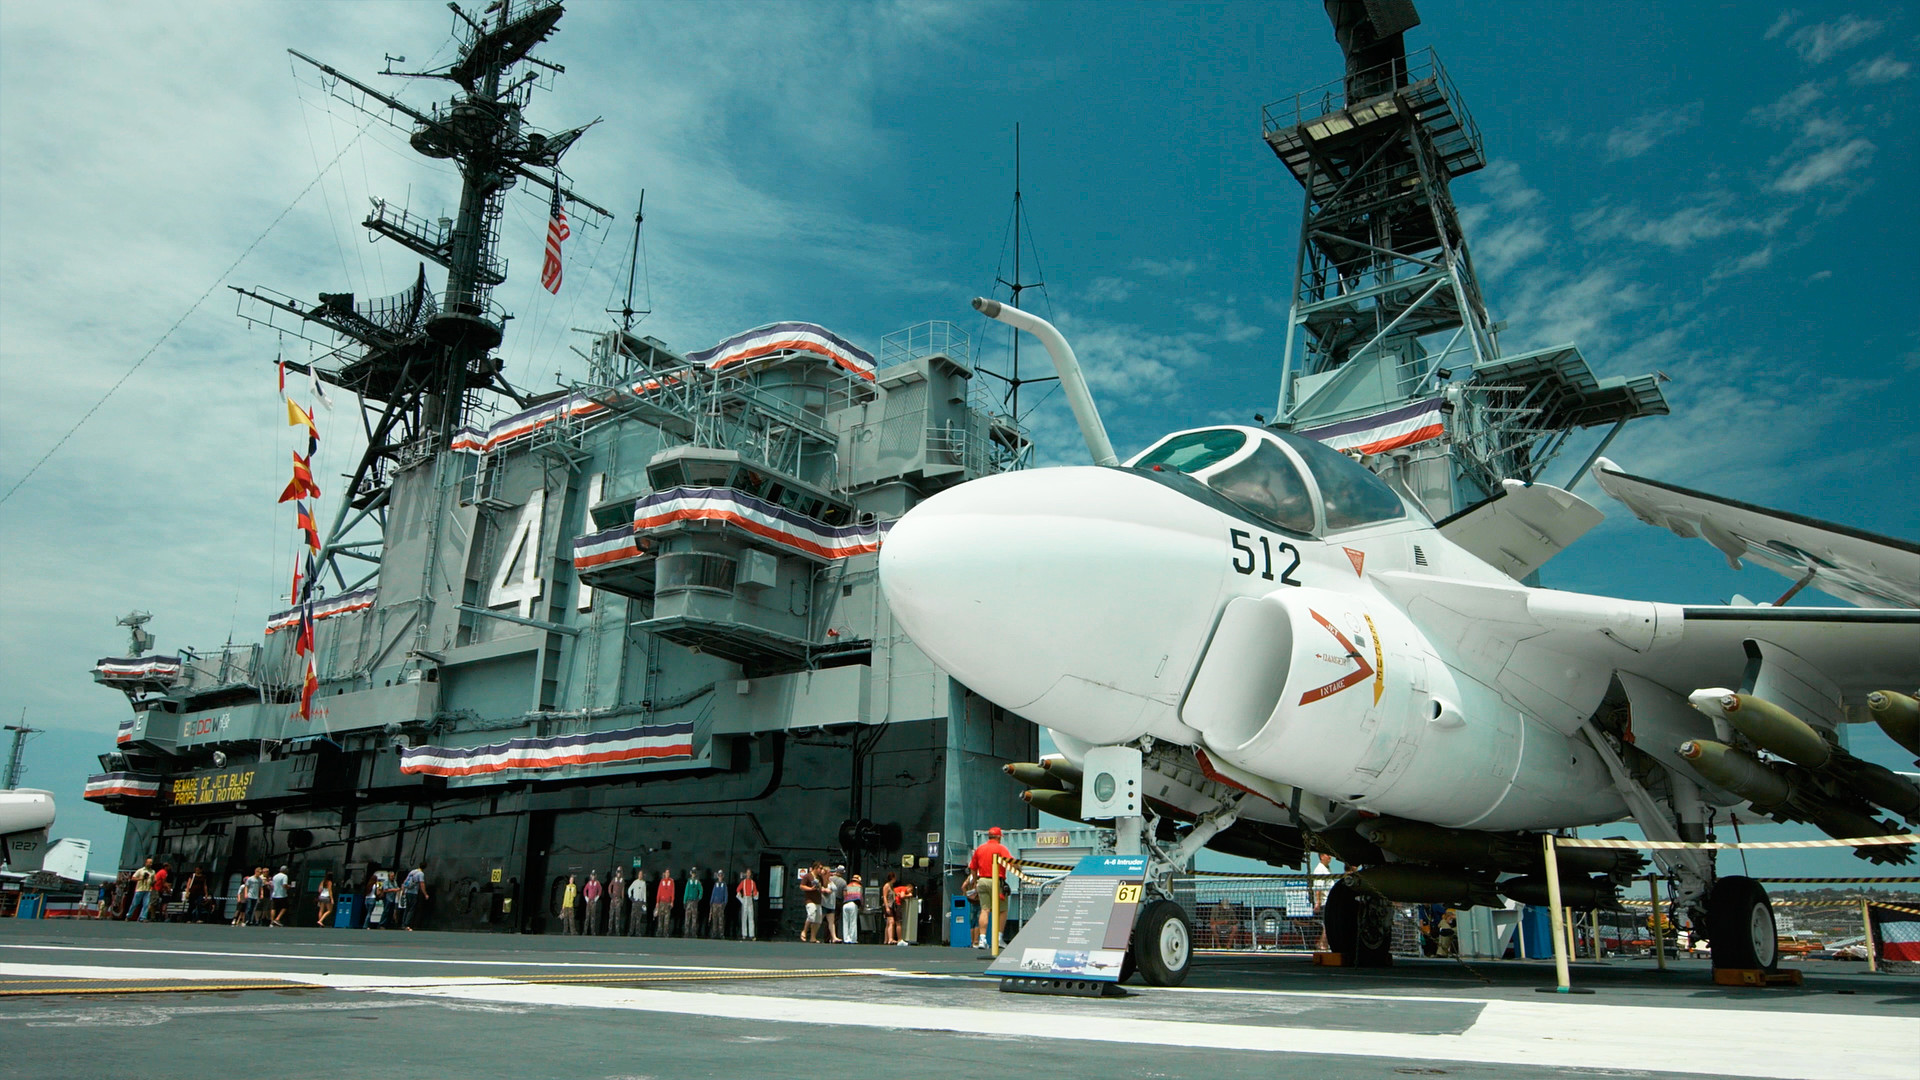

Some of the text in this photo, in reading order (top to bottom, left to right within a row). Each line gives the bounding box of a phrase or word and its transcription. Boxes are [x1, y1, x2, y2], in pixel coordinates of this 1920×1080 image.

[1230, 528, 1301, 587] 512
[1326, 623, 1339, 636] JET
[1364, 614, 1383, 681] RESCUE
[1322, 653, 1348, 667] DANGER
[1320, 679, 1345, 697] INTAKE
[136, 715, 144, 731] E
[173, 771, 255, 792] BEWARE OF JET BLAST
[174, 786, 247, 805] PROPS AND ROTORS
[12, 841, 38, 851] 1227
[1037, 836, 1069, 844] CAFE 41
[1118, 887, 1137, 901] 61
